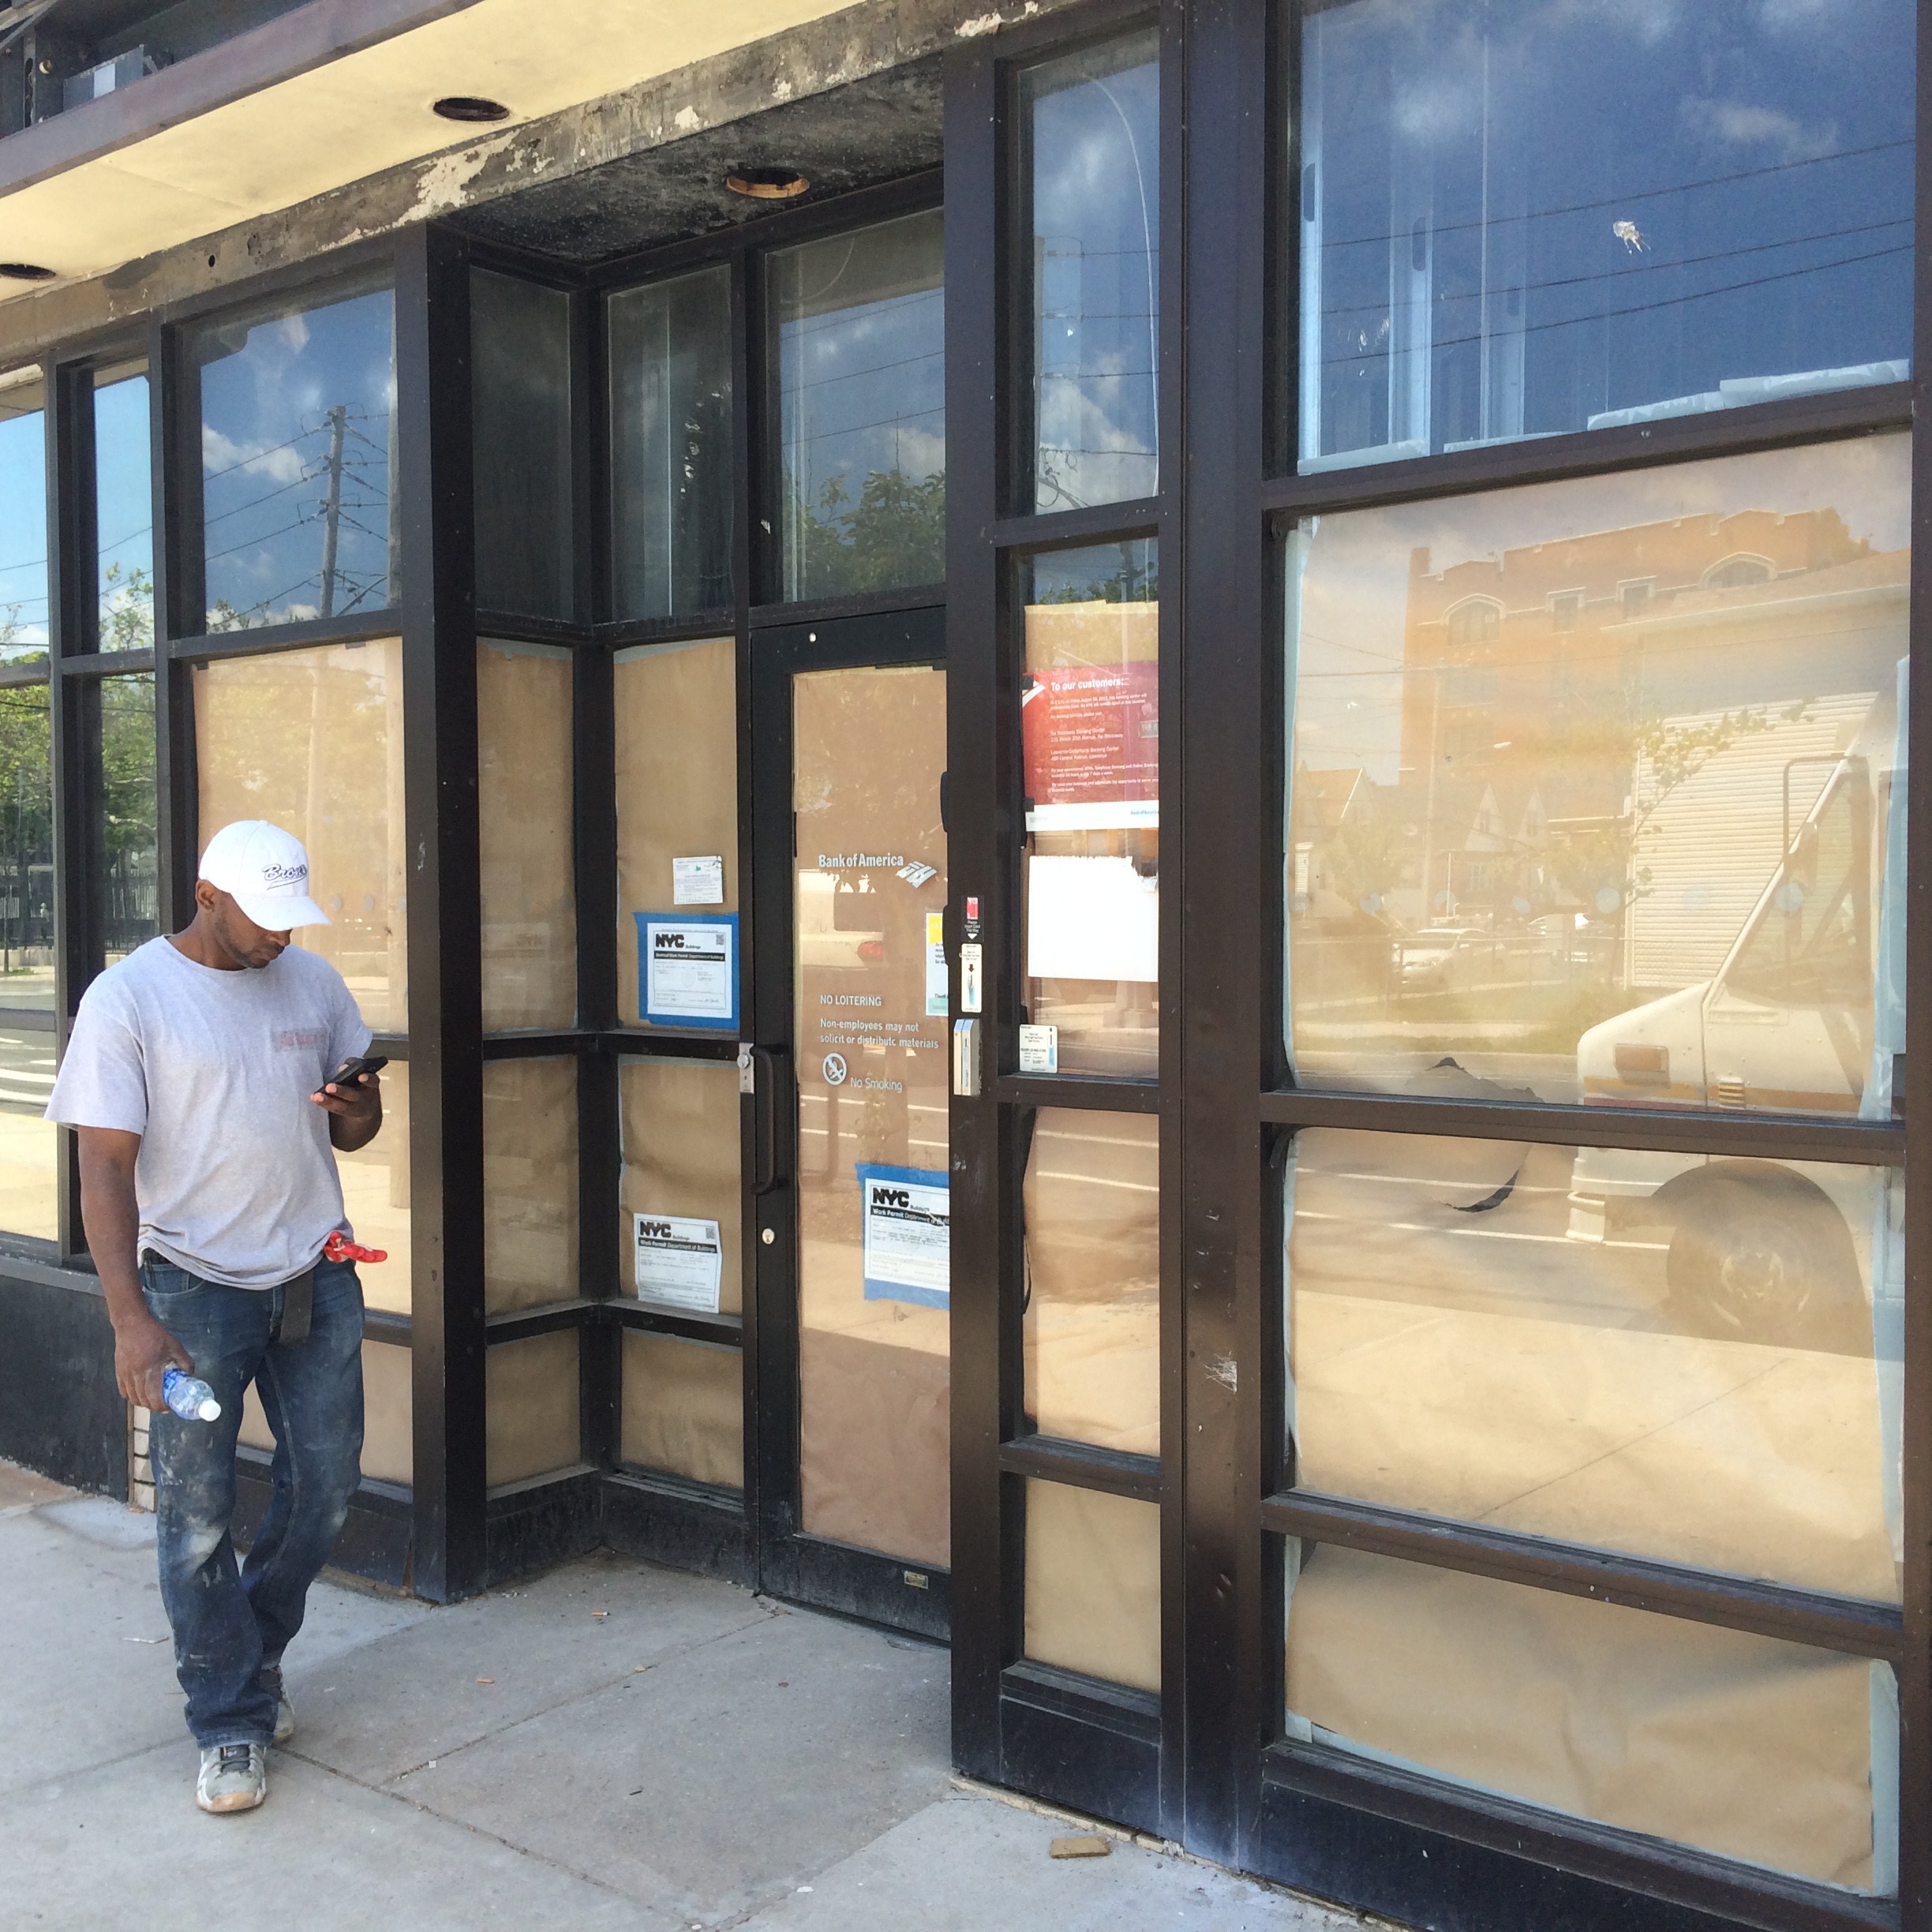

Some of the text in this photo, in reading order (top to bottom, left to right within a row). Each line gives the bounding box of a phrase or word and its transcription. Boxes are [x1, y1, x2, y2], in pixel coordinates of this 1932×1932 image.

[1051, 682, 1061, 691] To
[1078, 679, 1124, 689] customers:
[818, 852, 904, 867] Bank of America
[656, 933, 685, 948] NYC
[820, 994, 882, 1006] NO LOITERING
[820, 1018, 919, 1033] Non-employees may not
[820, 1034, 844, 1043] solicit
[899, 1039, 939, 1048] materials
[851, 1077, 903, 1093] No Smoking
[873, 1187, 909, 1208] NYC
[639, 1221, 671, 1237] NYC
